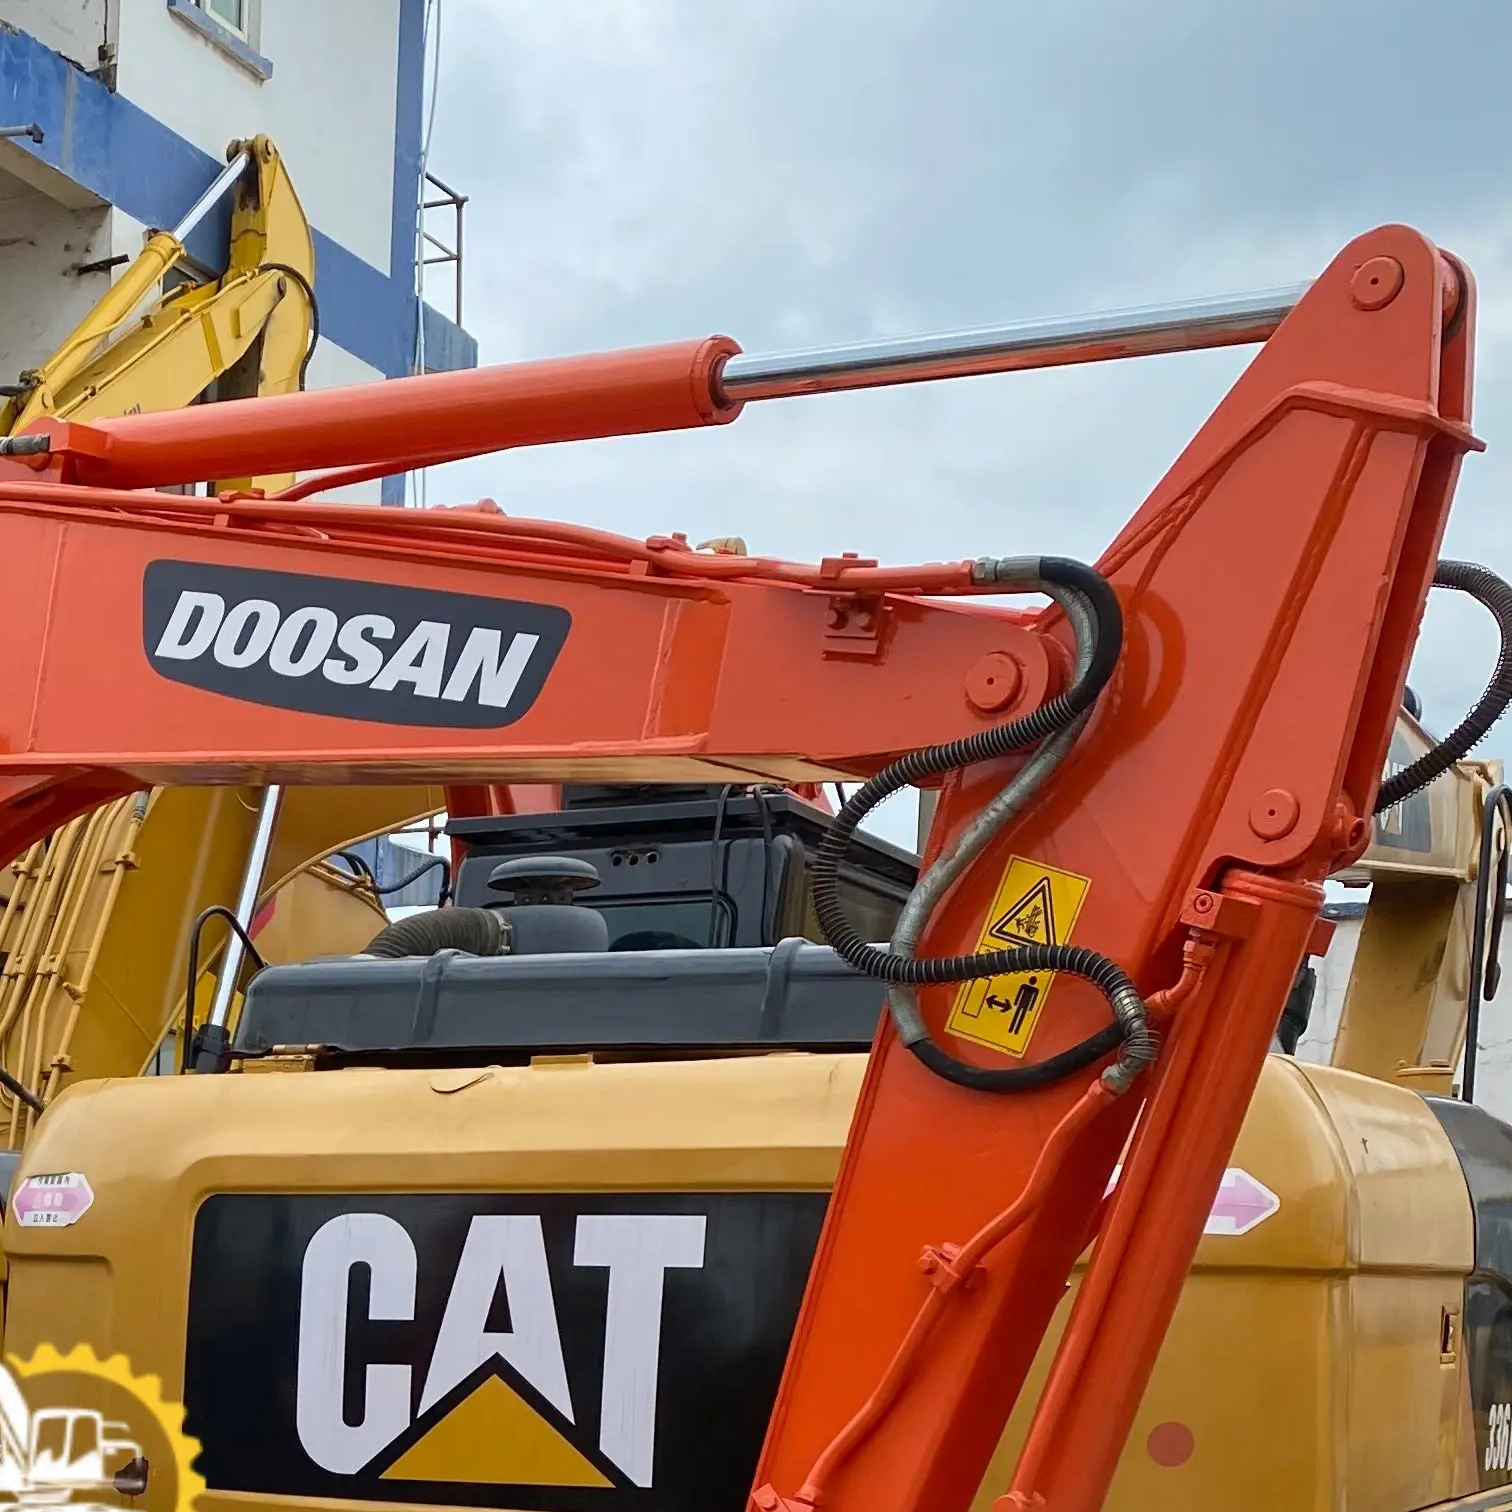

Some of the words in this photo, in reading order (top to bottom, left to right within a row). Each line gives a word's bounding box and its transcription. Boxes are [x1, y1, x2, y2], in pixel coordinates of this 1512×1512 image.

[154, 590, 540, 708] DOOSAN
[296, 1213, 707, 1488] CAT
[1485, 1404, 1512, 1471] 336
